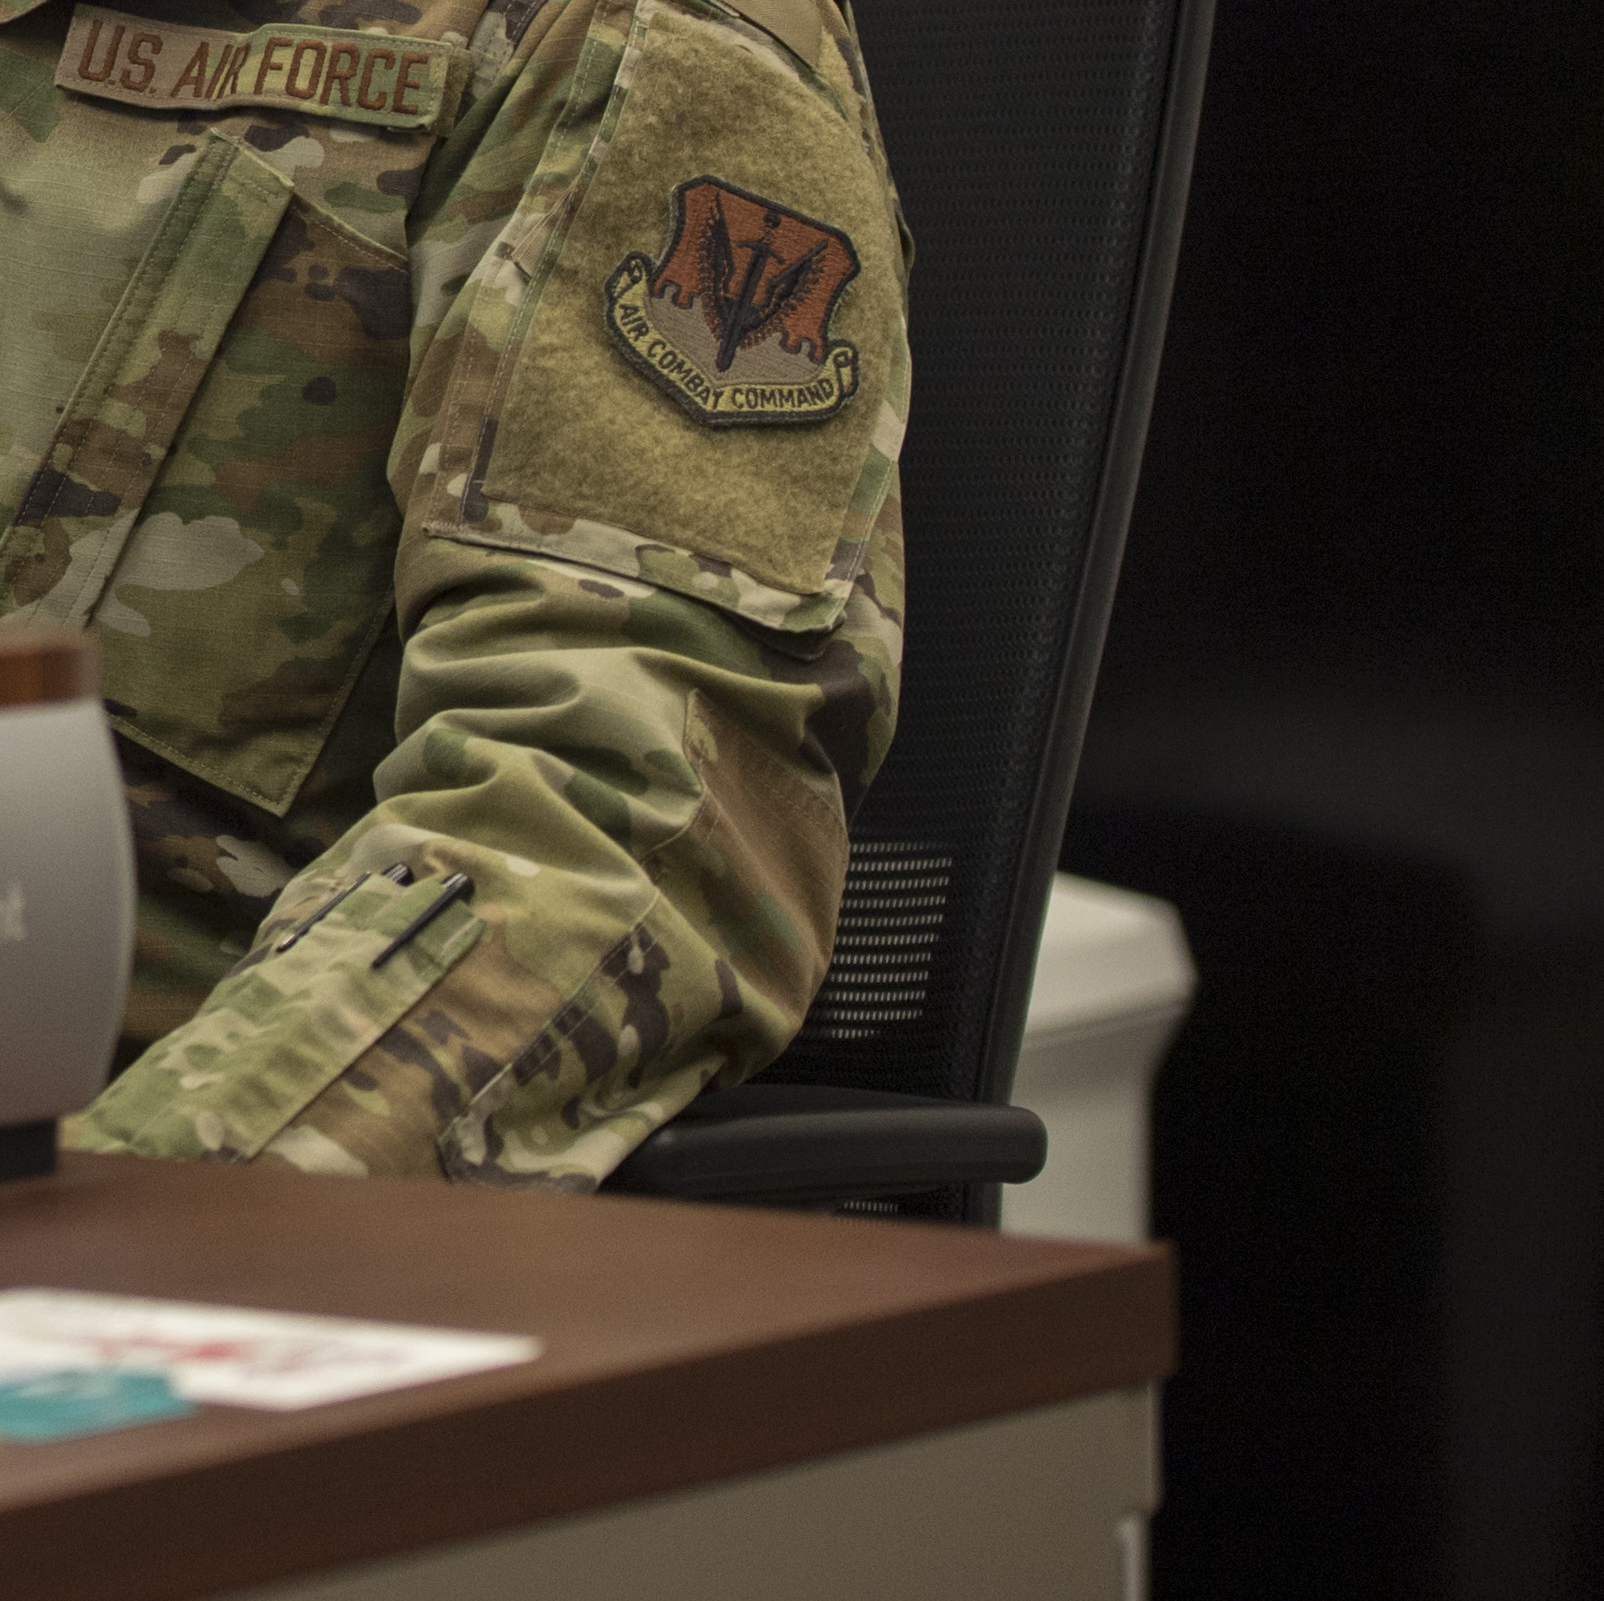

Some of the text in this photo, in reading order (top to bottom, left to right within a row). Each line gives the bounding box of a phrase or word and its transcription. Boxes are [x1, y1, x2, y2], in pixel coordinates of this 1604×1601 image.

[77, 19, 430, 115] U.S. AIR FORCE
[618, 302, 835, 411] AIR COMBAT COMMAND
